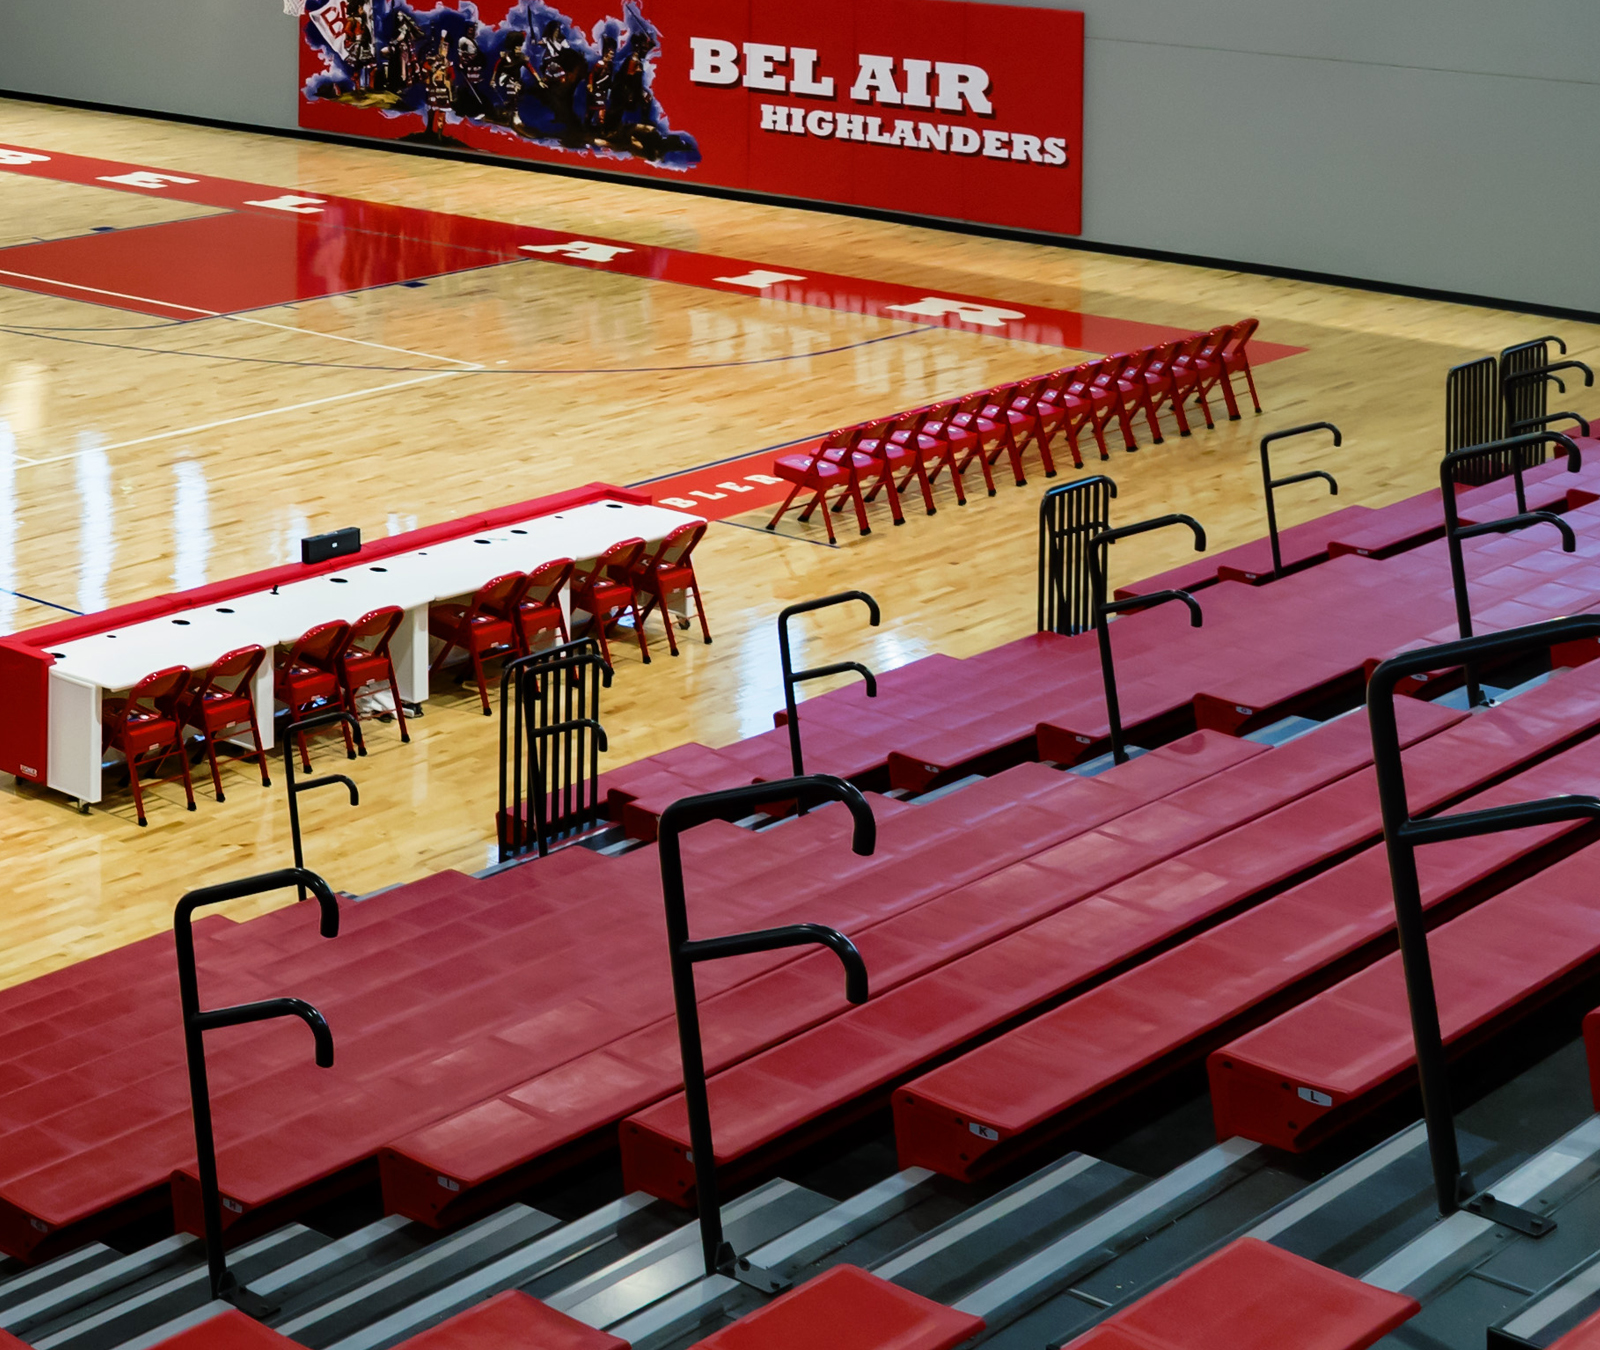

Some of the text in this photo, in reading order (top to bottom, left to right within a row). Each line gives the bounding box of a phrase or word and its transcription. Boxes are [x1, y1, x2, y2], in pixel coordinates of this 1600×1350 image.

[689, 37, 993, 115] BEL AIR
[760, 104, 1067, 166] HIGHLANDERS
[1310, 1090, 1320, 1103] L
[978, 1124, 989, 1138] K
